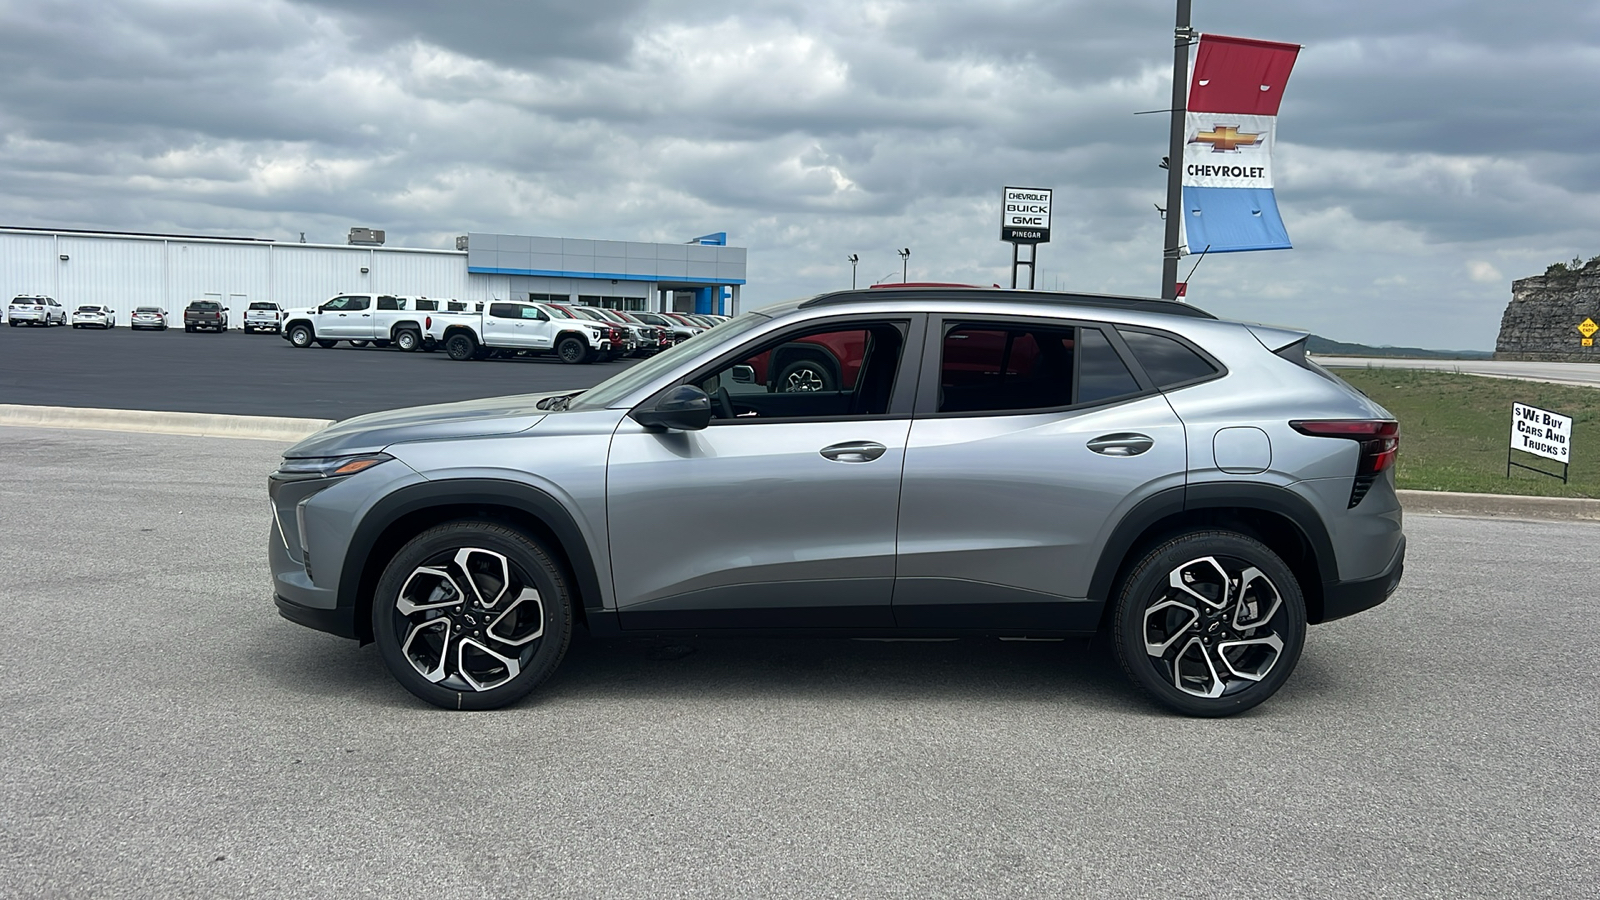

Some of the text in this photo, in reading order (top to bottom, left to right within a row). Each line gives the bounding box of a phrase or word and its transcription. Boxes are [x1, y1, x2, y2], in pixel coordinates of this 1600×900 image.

[1008, 193, 1048, 201] CHEVROLET
[1007, 205, 1048, 213] BUICK
[1012, 217, 1042, 225] GMC
